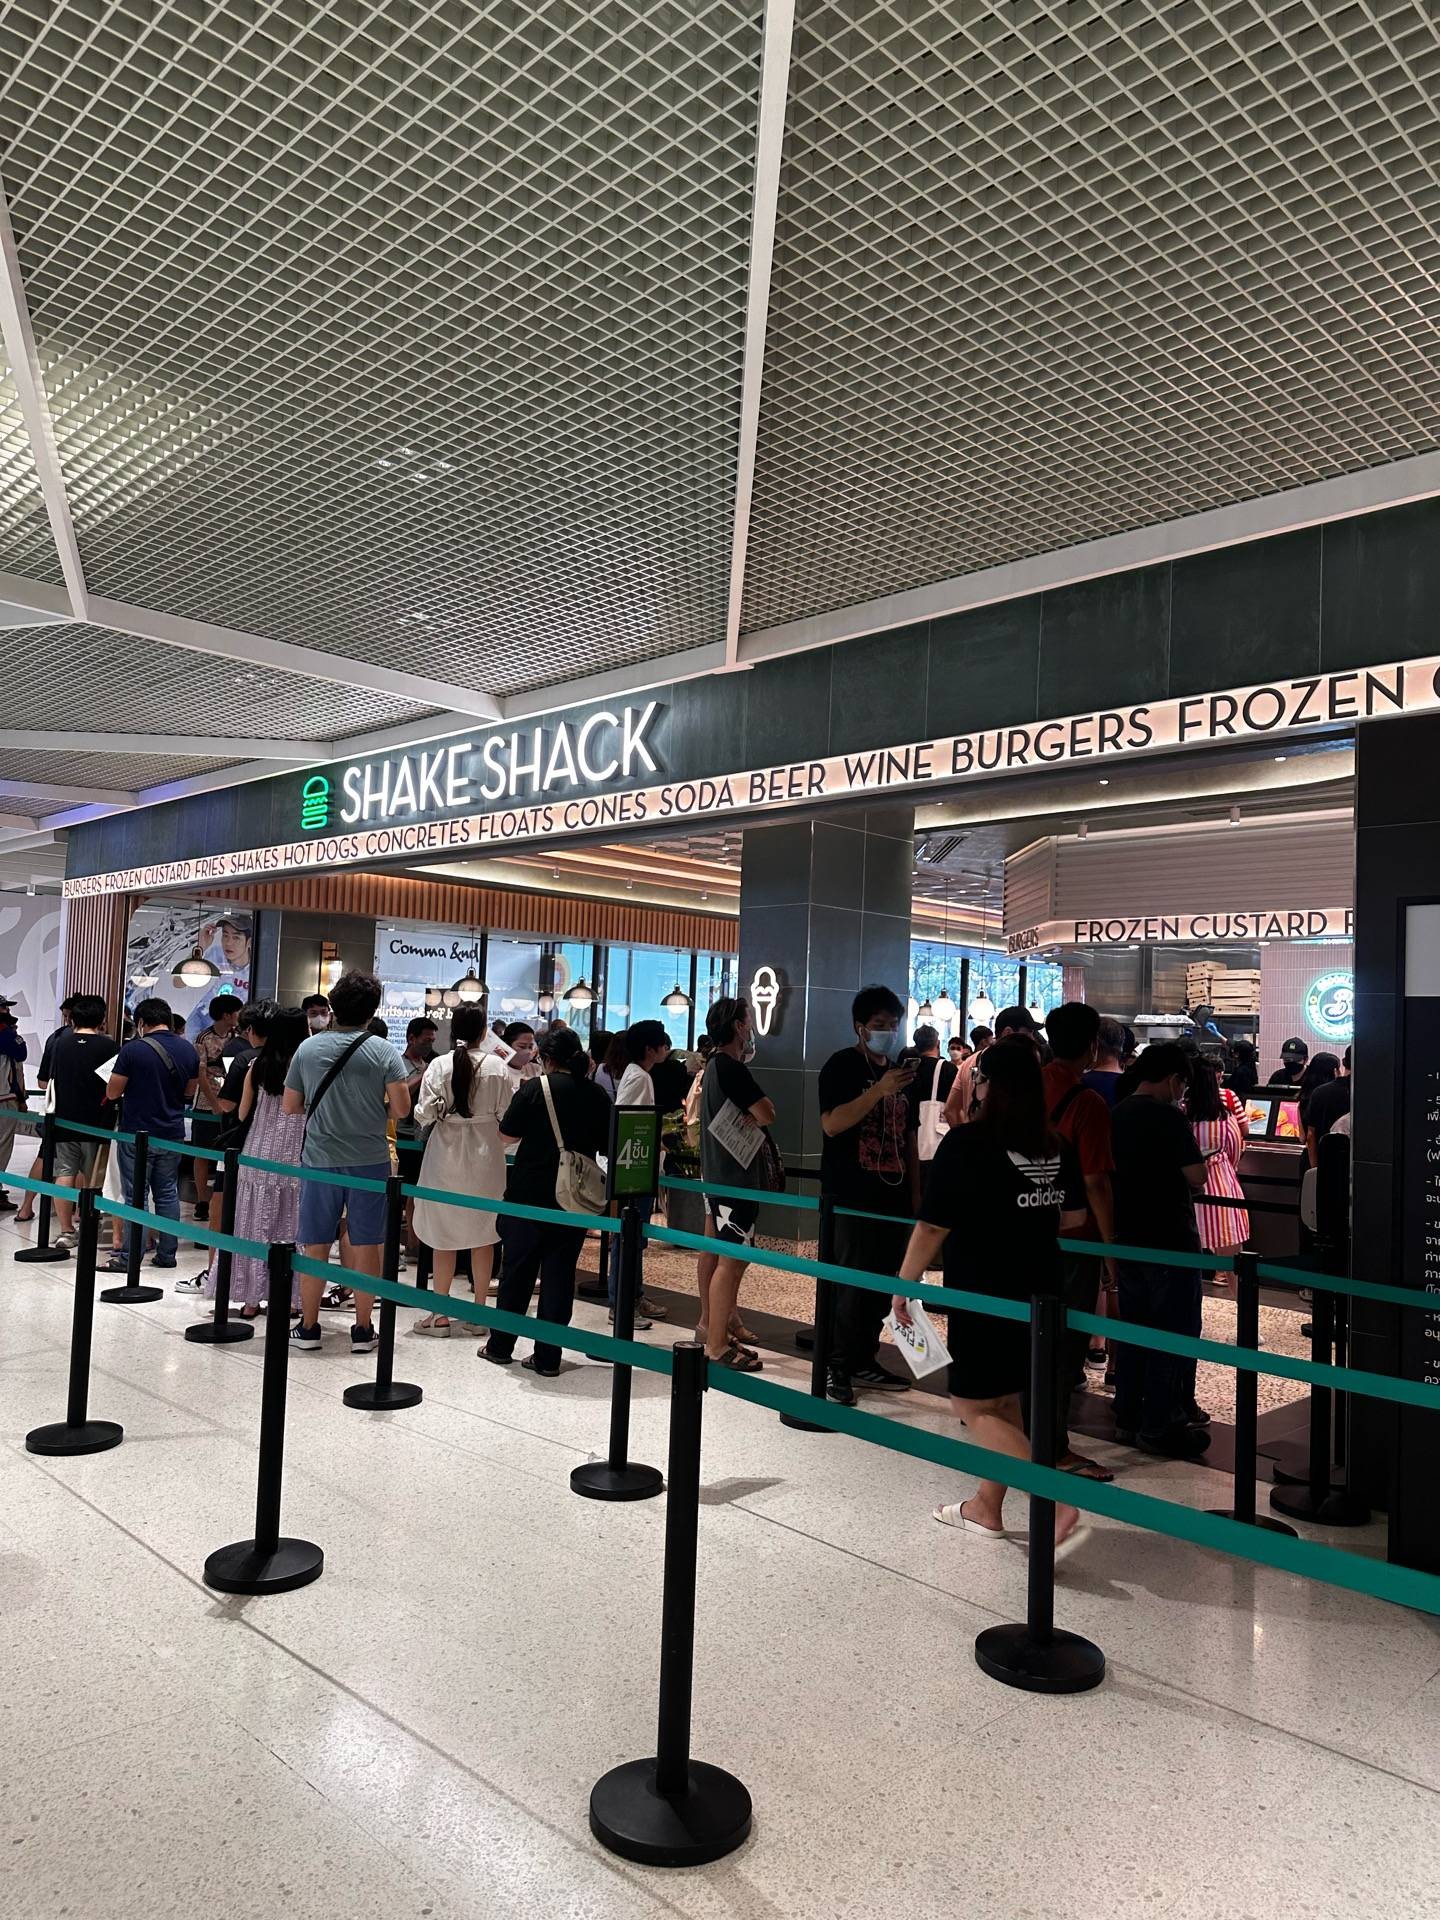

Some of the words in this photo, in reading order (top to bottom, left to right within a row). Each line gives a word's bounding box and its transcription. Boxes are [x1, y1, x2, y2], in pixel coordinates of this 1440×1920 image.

[340, 743, 472, 823] SHAKE
[480, 701, 657, 800] SHACK
[63, 876, 102, 897] BURGERS
[105, 869, 142, 891] FROZEN
[144, 861, 191, 886] CUSTARD
[195, 857, 225, 881] FRIES
[230, 849, 279, 874] SHAKES
[284, 843, 314, 866] HOT
[317, 836, 359, 861] DOGS
[366, 819, 470, 857] CONCRETES
[479, 806, 554, 840] FLOATS
[564, 791, 647, 829] CONES
[658, 779, 734, 816] SODA
[749, 763, 826, 804] BEER
[844, 743, 934, 787] WINE
[951, 707, 1153, 775] BURGERS
[1178, 665, 1404, 743] FROZEN
[1008, 927, 1039, 954] BURGERS
[1074, 917, 1180, 943] FROZEN
[1190, 910, 1328, 939] CUSTARD
[389, 939, 447, 959] Comma
[616, 1138, 633, 1170] 4
[1017, 1188, 1066, 1208] adidas
